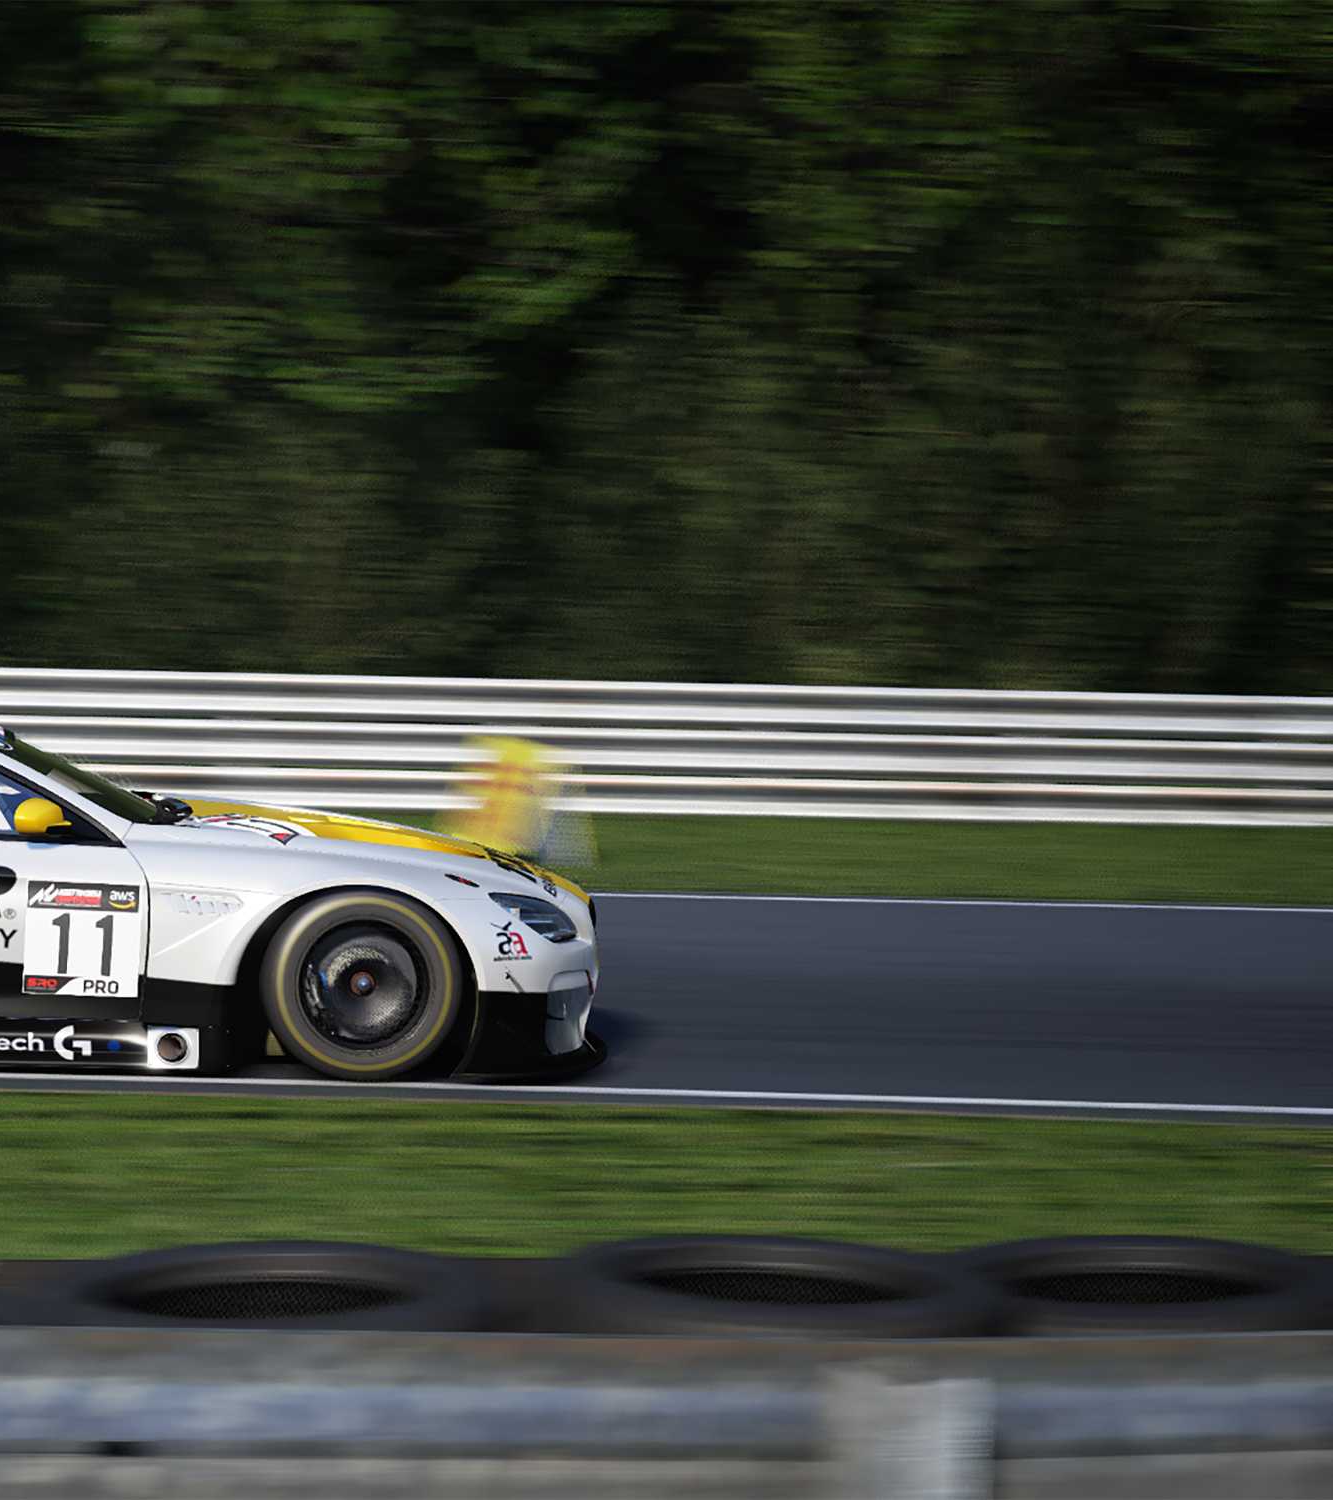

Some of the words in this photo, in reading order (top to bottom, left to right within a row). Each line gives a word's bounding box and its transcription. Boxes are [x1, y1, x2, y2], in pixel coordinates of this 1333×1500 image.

[109, 890, 135, 901] aws
[52, 913, 113, 977] 11
[83, 980, 119, 994] PRO
[53, 1025, 92, 1060] G
